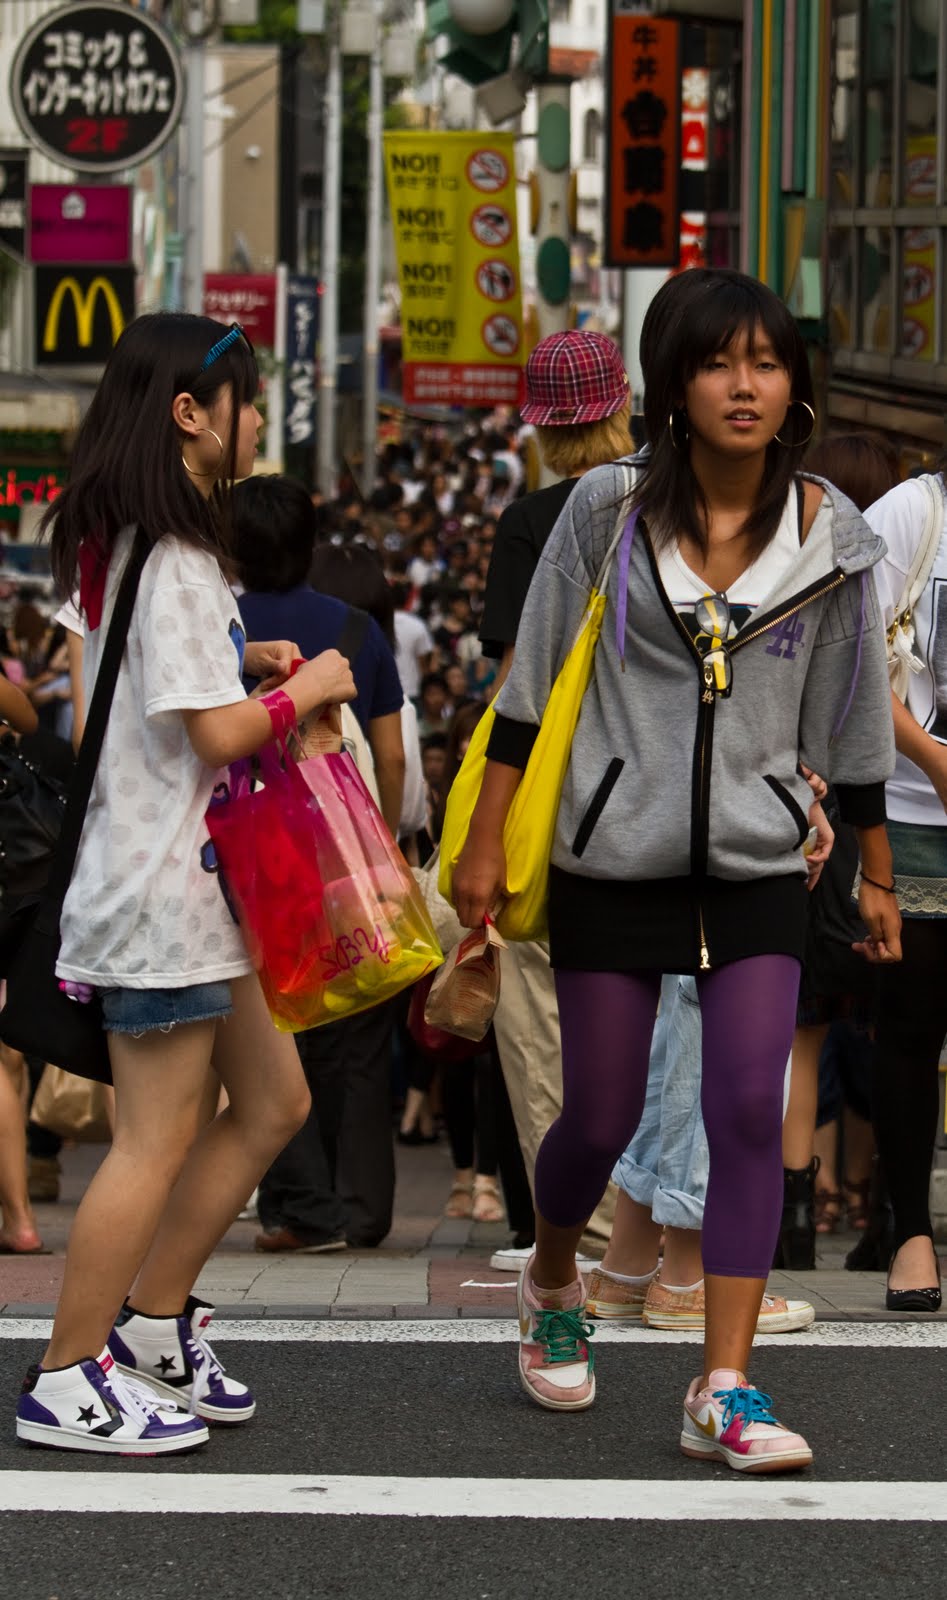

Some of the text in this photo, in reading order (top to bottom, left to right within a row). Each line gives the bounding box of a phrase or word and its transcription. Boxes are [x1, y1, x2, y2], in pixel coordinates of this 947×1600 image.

[24, 69, 170, 115] インターネットカフェ
[66, 118, 128, 151] 2F
